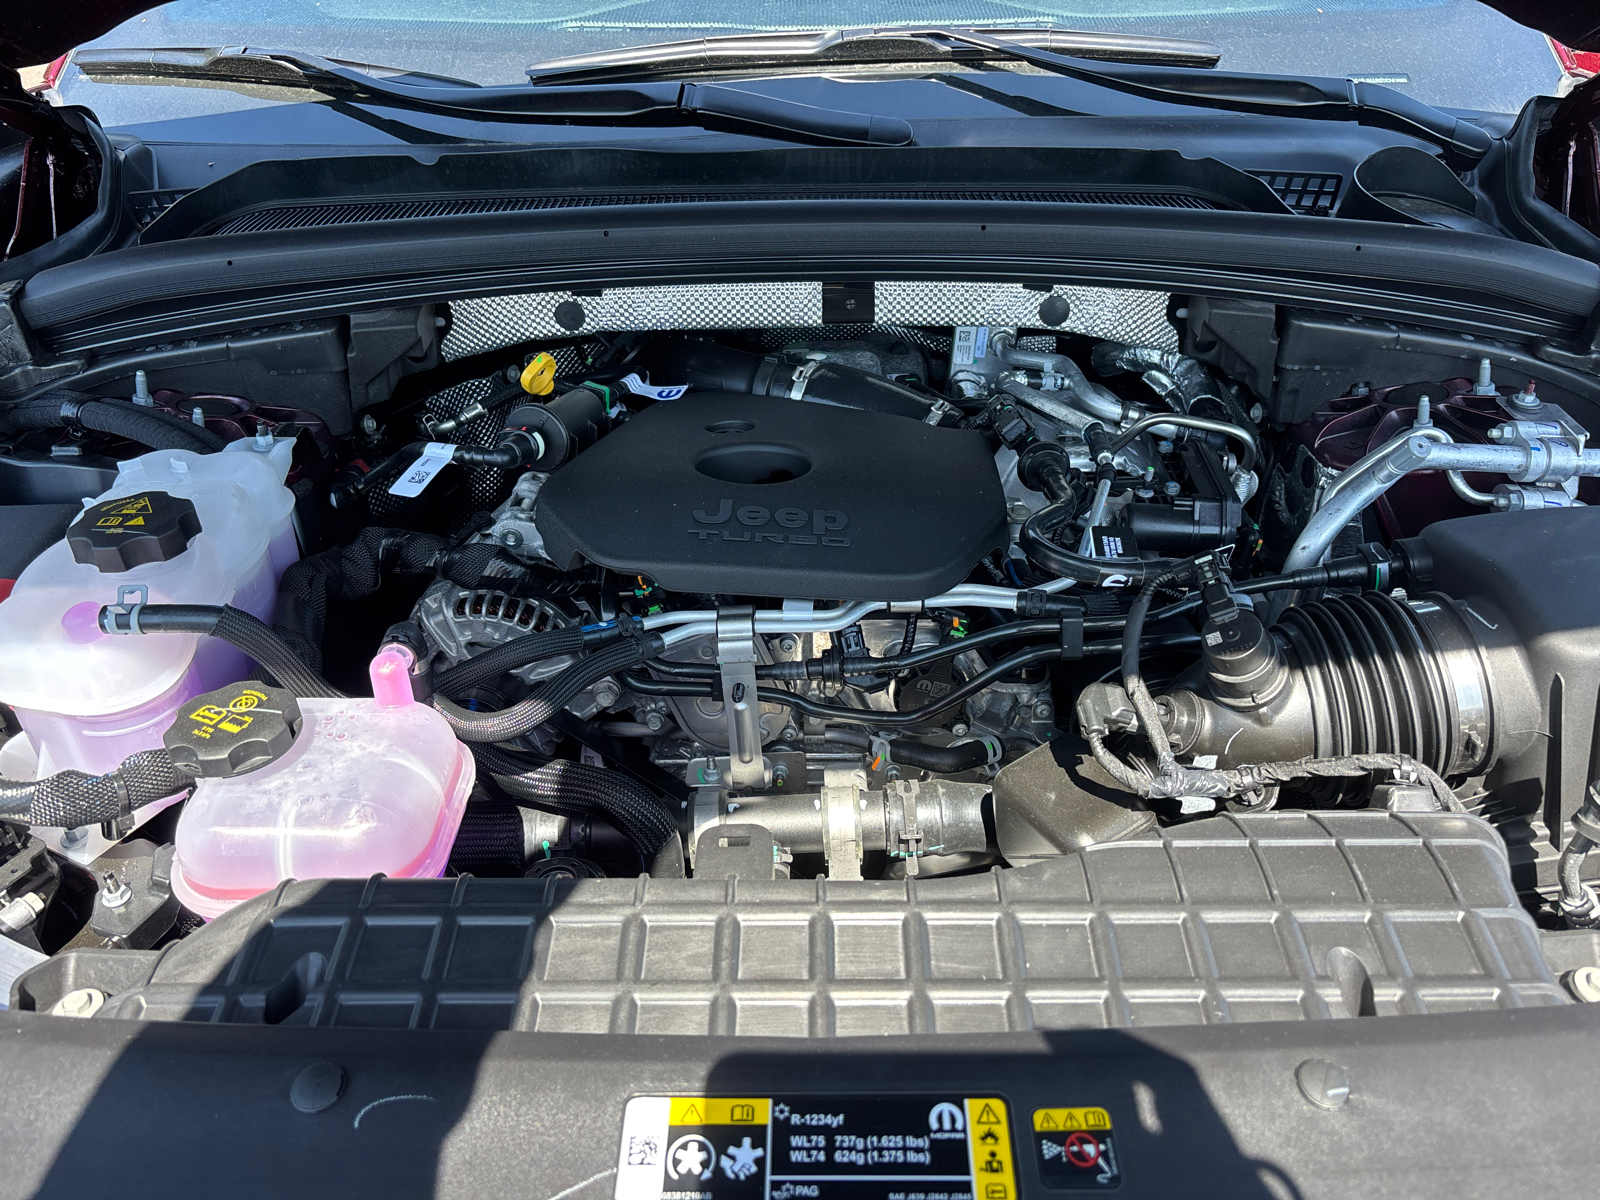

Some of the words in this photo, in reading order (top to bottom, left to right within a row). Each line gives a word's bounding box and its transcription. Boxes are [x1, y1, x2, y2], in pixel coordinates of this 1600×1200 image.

[692, 498, 849, 535] Jeep
[688, 529, 852, 548] TURBO
[790, 1113, 845, 1127] R-1234yf
[790, 1135, 826, 1148] WL75
[834, 1135, 865, 1150] 737g
[867, 1135, 903, 1149] (1.625
[906, 1135, 930, 1149] lbs)
[790, 1150, 826, 1162] WL74
[834, 1150, 865, 1164] 624g
[867, 1150, 904, 1164] (1.375
[906, 1150, 931, 1164] lbs)
[795, 1186, 819, 1196] PAG
[888, 1192, 905, 1200] SAE
